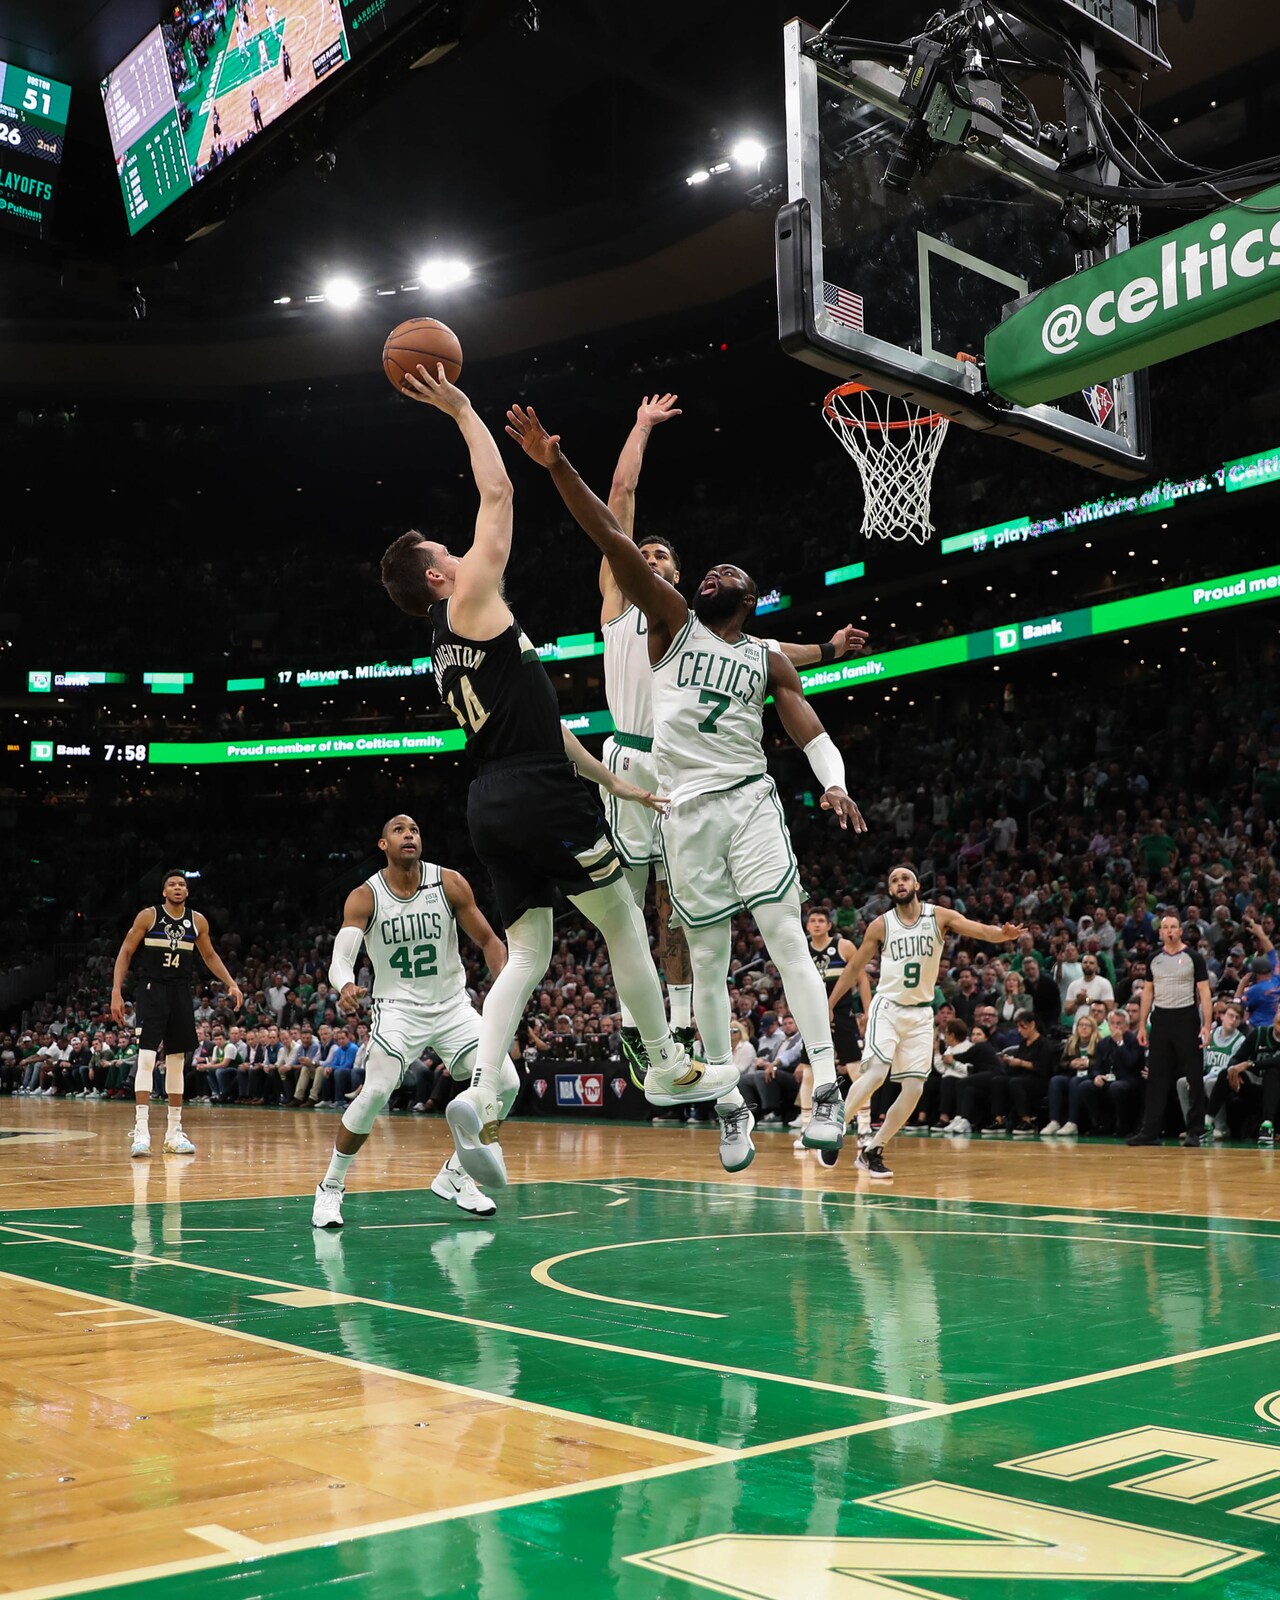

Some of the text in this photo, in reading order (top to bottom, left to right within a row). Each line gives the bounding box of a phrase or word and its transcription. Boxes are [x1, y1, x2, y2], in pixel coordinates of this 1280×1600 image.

[27, 75, 51, 91] BOSTON
[22, 88, 52, 115] 51
[37, 139, 58, 154] 2nd
[0, 168, 53, 201] LAYOFFS
[7, 202, 43, 219] Putnam
[995, 628, 1018, 649] TD
[1022, 618, 1063, 640] Bank
[1192, 578, 1247, 605] Proud
[277, 670, 293, 684] 17
[296, 669, 354, 685] players.
[677, 651, 762, 706] CELTICS
[800, 660, 885, 690] Celtics family.
[697, 688, 732, 734] 7
[33, 744, 51, 758] TD
[56, 744, 91, 756] Bank
[104, 744, 147, 761] 7:58
[227, 745, 264, 757] Proud
[264, 741, 317, 755] member
[318, 740, 333, 753] of
[333, 738, 355, 751] the
[355, 737, 401, 751] Celtics
[401, 735, 445, 750] family.
[381, 912, 442, 945] CELTICS
[162, 952, 180, 969] 34
[389, 943, 438, 979] 42
[890, 935, 934, 961] CELTICS
[903, 962, 921, 989] 9
[559, 1080, 575, 1100] NBA
[584, 1086, 601, 1096] TNT
